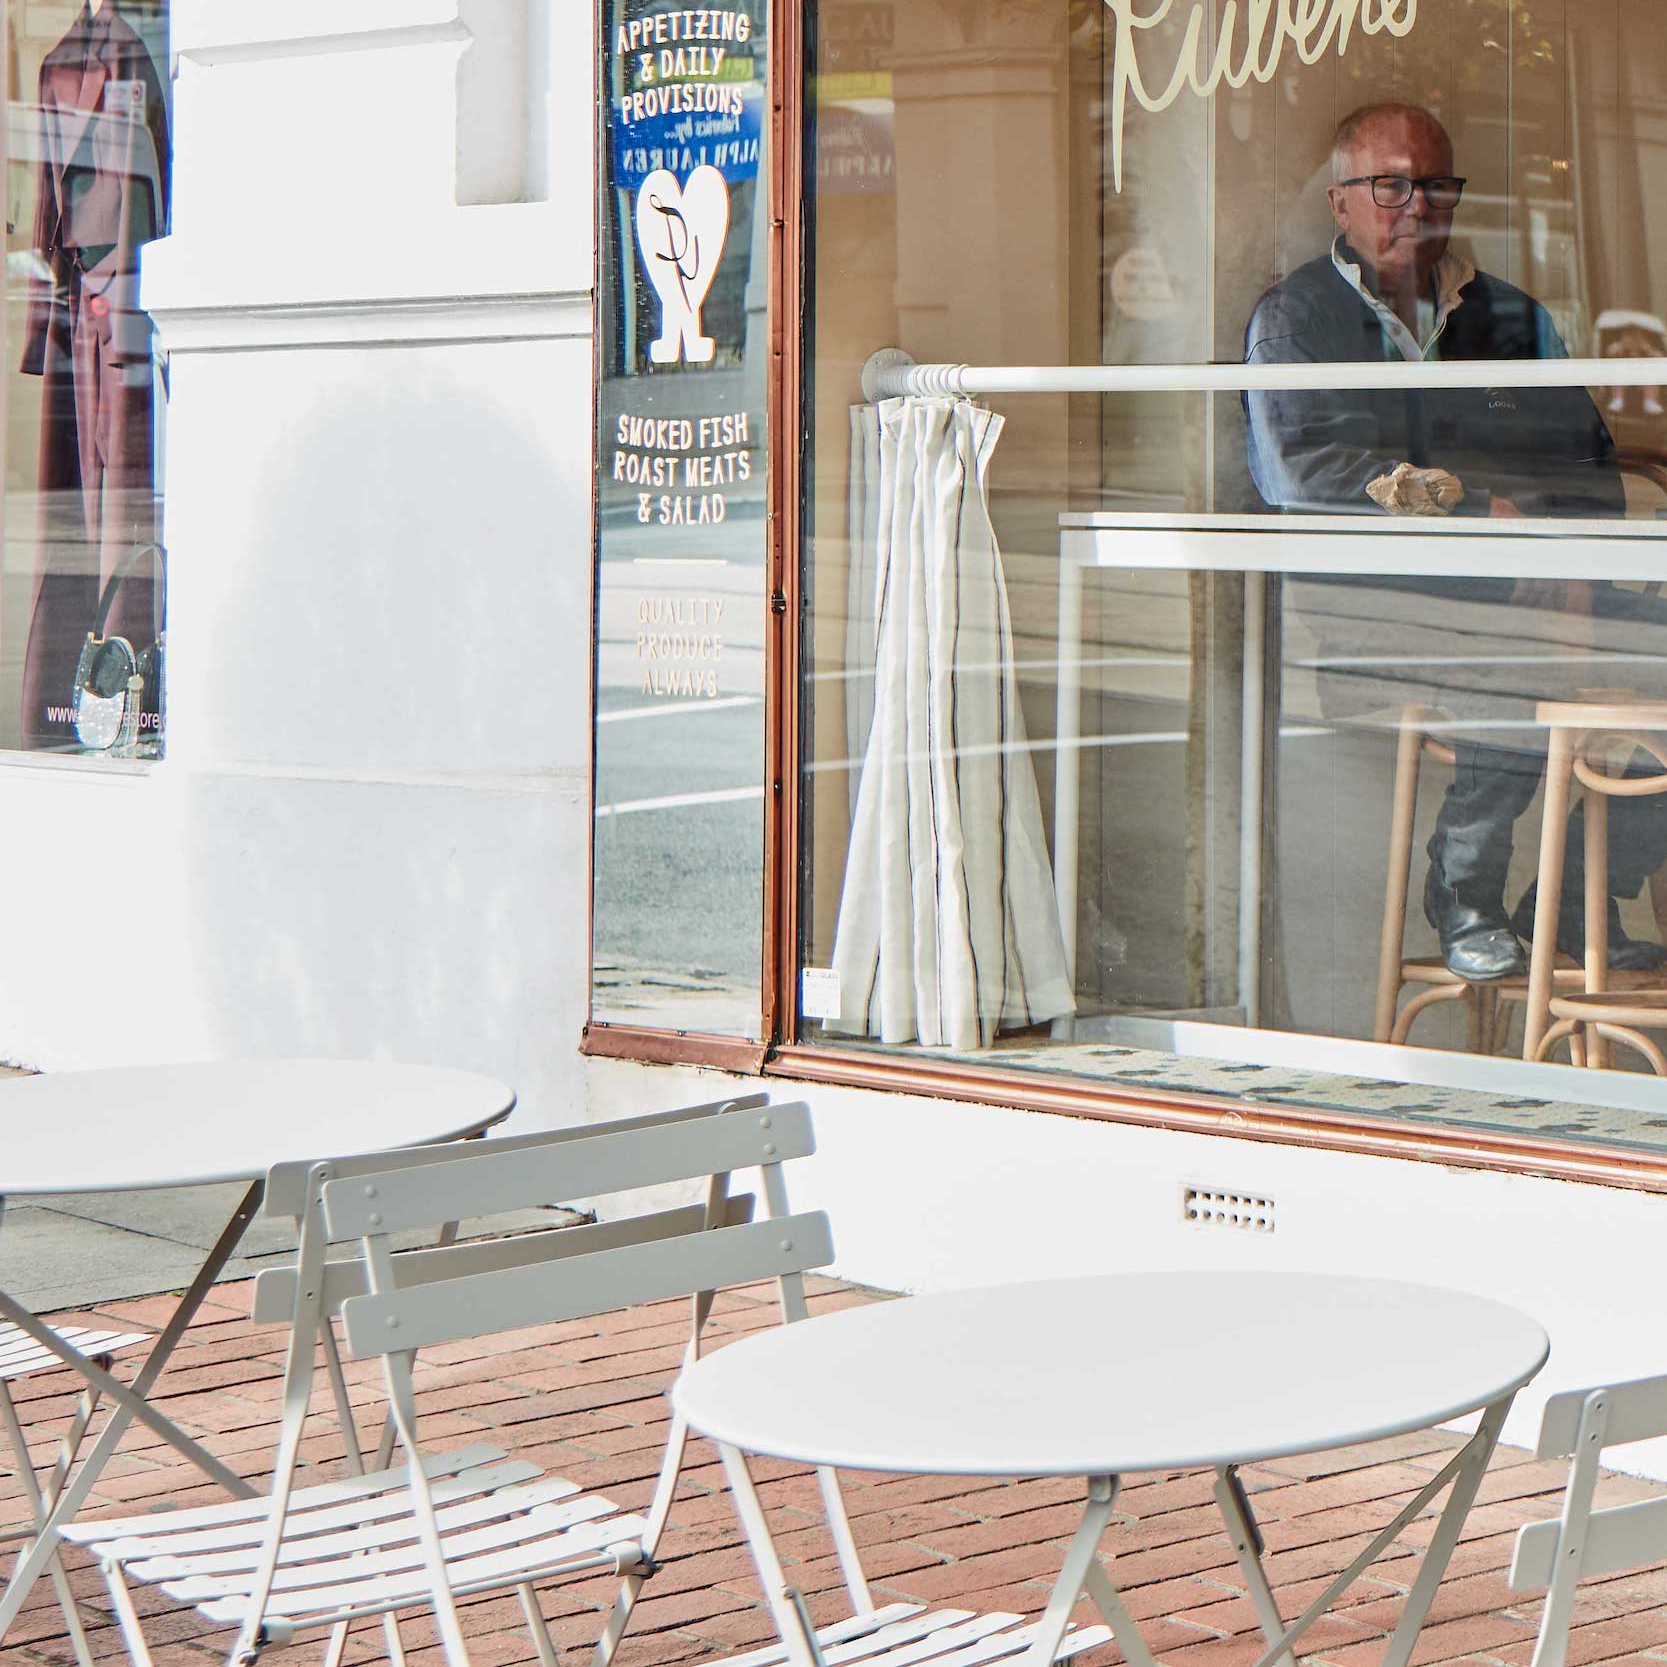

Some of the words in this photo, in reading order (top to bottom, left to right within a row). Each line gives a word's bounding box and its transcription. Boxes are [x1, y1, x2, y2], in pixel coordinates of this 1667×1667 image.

[616, 9, 751, 55] APPETIZING
[639, 52, 655, 82] &
[660, 47, 726, 78] DAILY
[621, 83, 744, 125] PROVISIONS
[616, 413, 693, 451] SMOKED
[699, 412, 749, 448] FISH
[613, 451, 678, 487] ROAST
[685, 450, 751, 488] MEATS
[637, 493, 653, 523] &
[659, 494, 727, 525] SALAD
[639, 597, 723, 626] QUALITY
[636, 634, 722, 662] PRODUCE
[641, 669, 719, 699] ALWAYS
